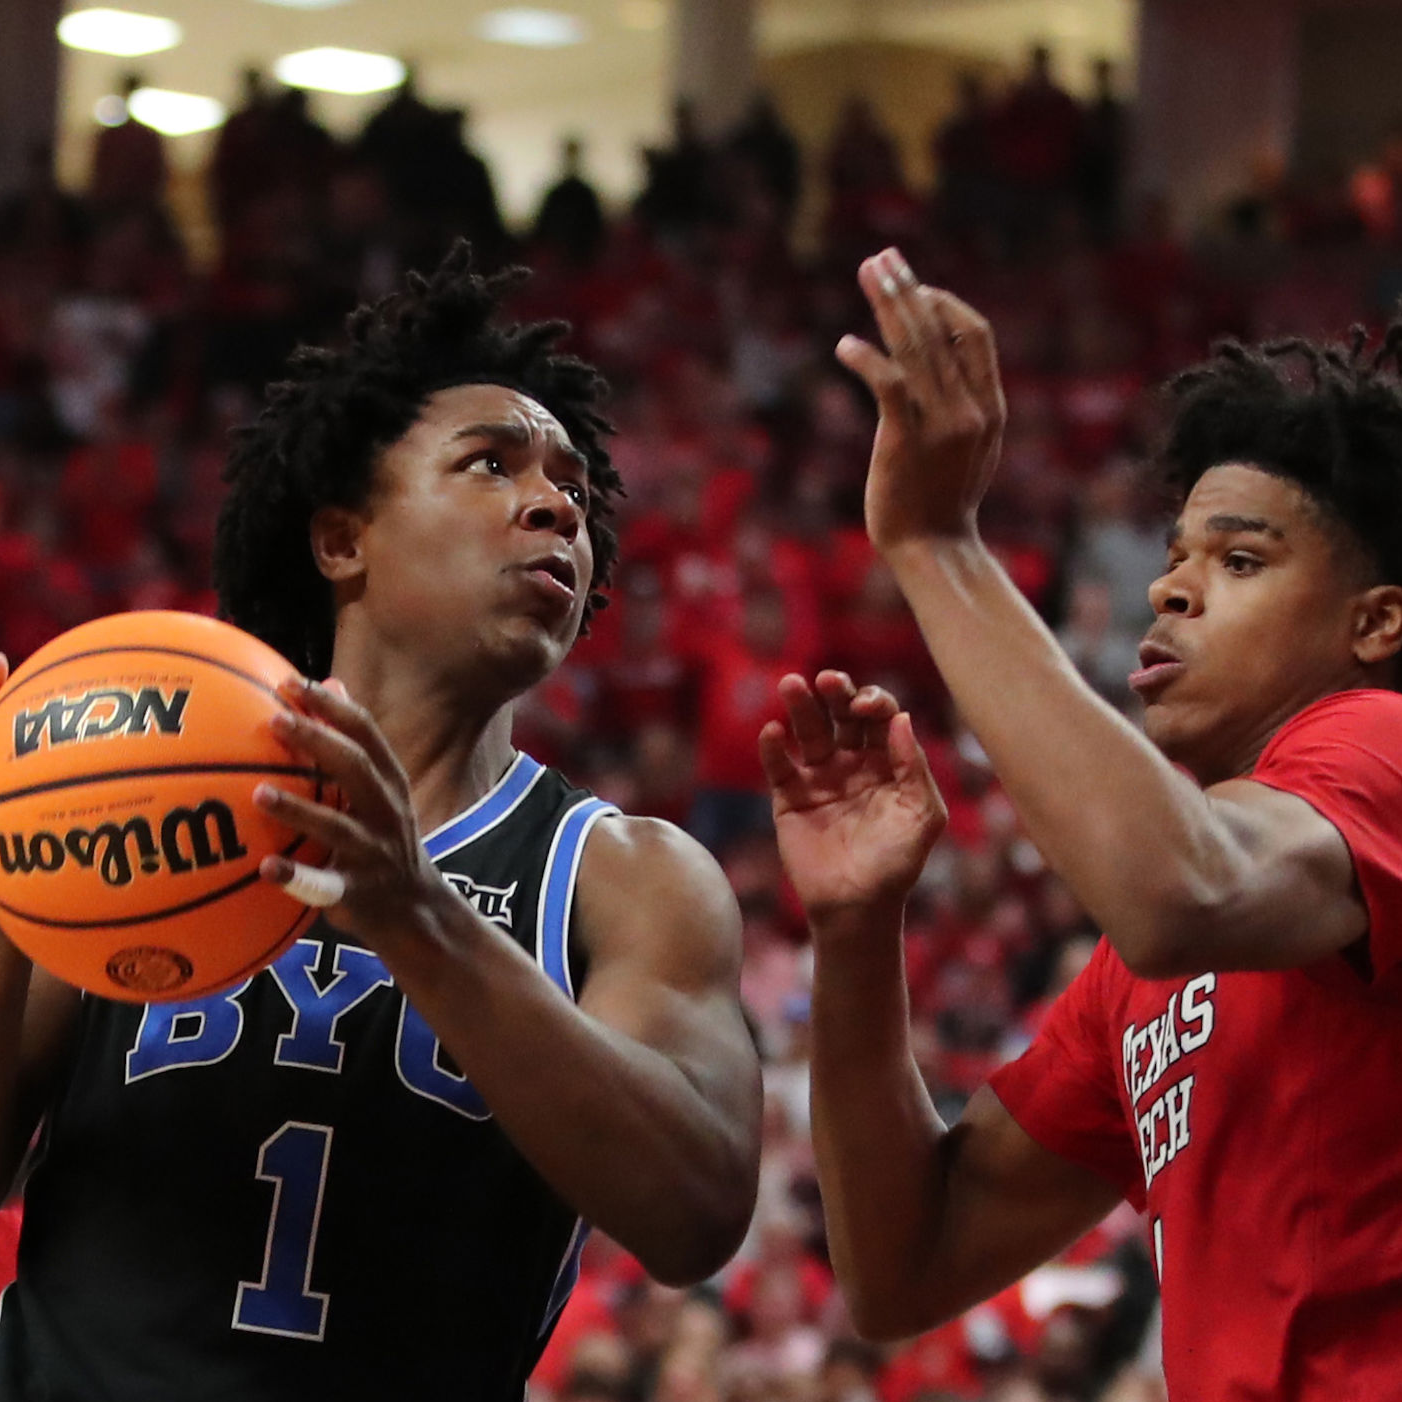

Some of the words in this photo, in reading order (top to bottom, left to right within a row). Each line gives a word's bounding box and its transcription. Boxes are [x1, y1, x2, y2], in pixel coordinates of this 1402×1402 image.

[13, 685, 192, 759] NCAA
[1134, 1075, 1195, 1191] ECH
[232, 1121, 334, 1342] 1
